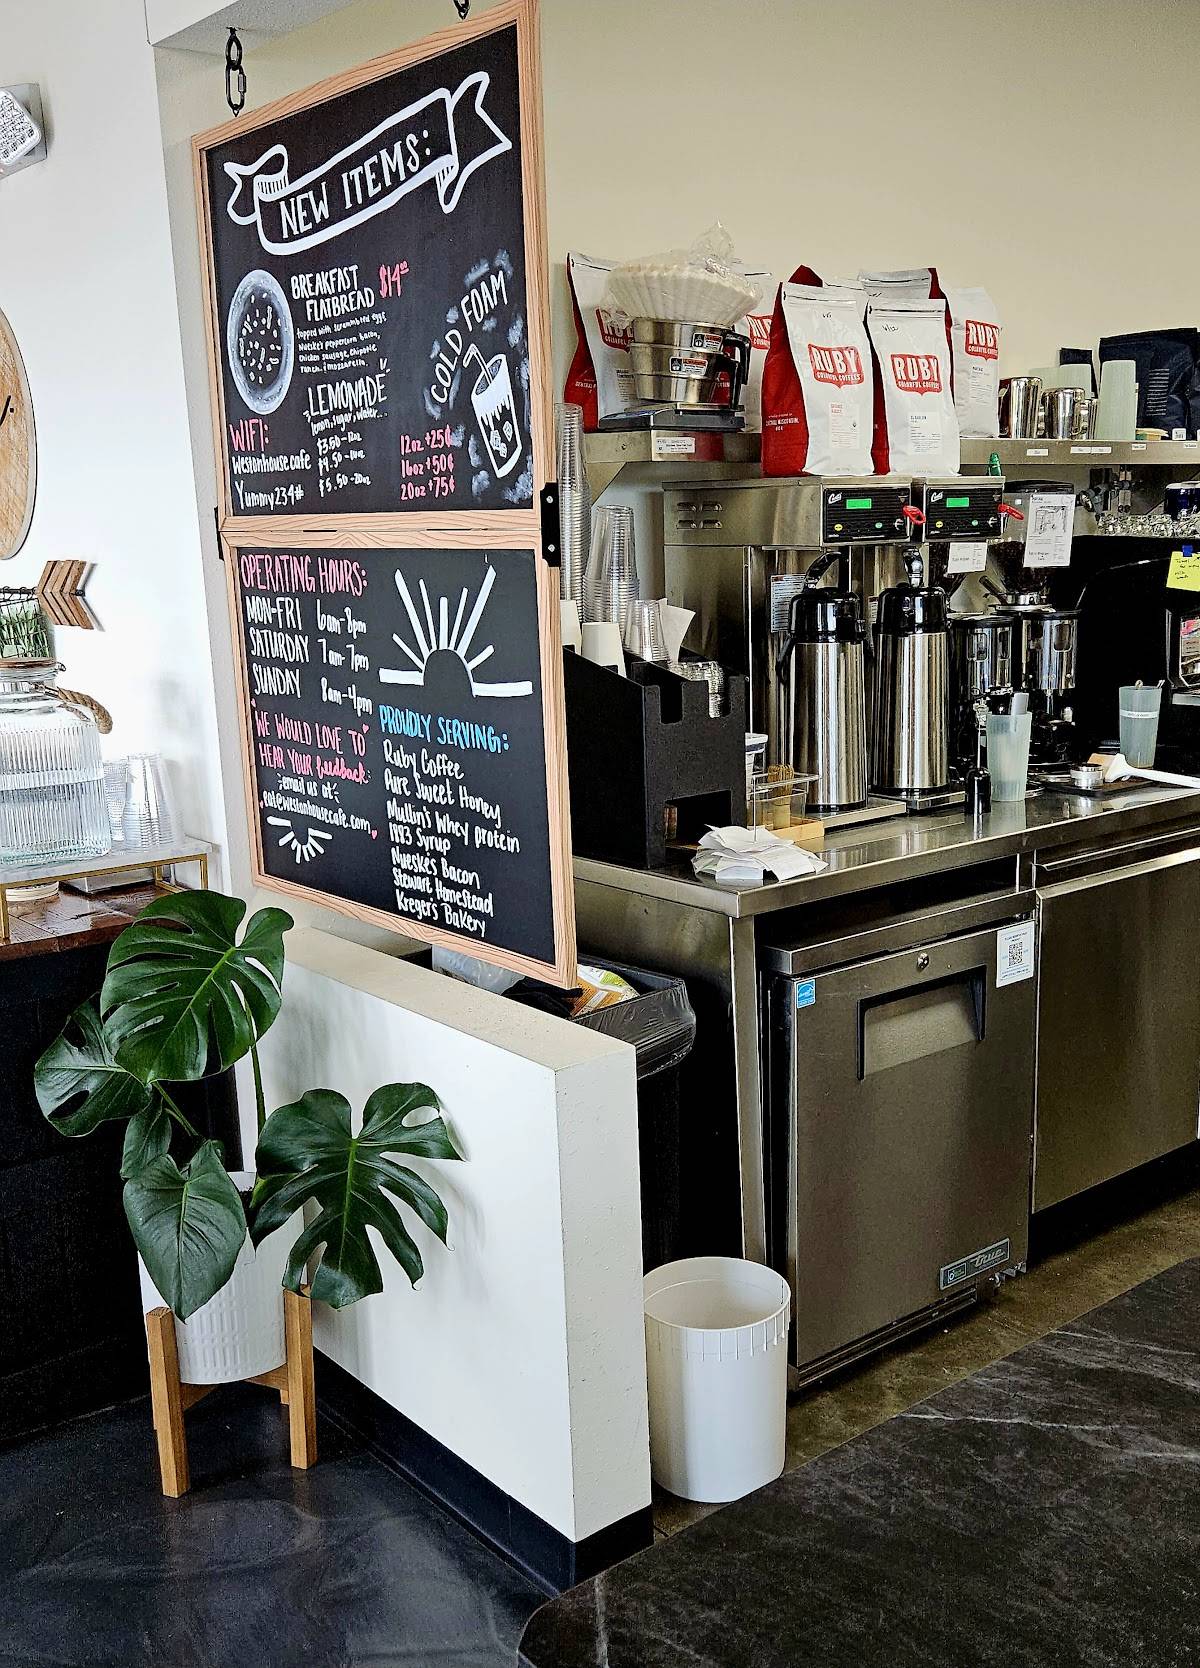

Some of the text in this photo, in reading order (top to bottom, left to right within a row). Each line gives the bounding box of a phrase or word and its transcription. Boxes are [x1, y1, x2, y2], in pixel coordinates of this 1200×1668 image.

[279, 130, 432, 239] NEW ITEMS:
[291, 264, 359, 300] BREAKFAST
[306, 287, 375, 322] FLATBREAD
[461, 270, 508, 332] FOAM
[318, 324, 332, 336] with
[967, 322, 999, 350] RUBY
[430, 328, 463, 404] COLD
[811, 346, 858, 375] RUBY
[893, 356, 939, 382] RUBY
[307, 373, 388, 417] LEMONADE
[229, 418, 269, 452] WIFI:
[400, 434, 425, 456] 12oz
[400, 481, 427, 501] 20oz
[240, 554, 368, 597] OPERATING HOURS:
[245, 595, 303, 631] MON-FRI
[250, 626, 310, 663] SATURDAY
[252, 662, 301, 699] SUNDAY
[254, 710, 367, 757] WE WOULD LOVE TO
[379, 704, 509, 754] PROUDLY SERVING:
[258, 742, 286, 770] HEAR
[287, 749, 314, 778] YOUR
[383, 738, 465, 780] Ruby Coffee
[282, 774, 334, 800] email us at
[384, 767, 502, 830] Pure Sweet Honey
[386, 797, 521, 854] Mullin's Whey protein
[415, 826, 452, 856] Syrup
[440, 856, 481, 890] Bacon
[434, 877, 494, 918] Homestead
[440, 902, 486, 938] Bakery
